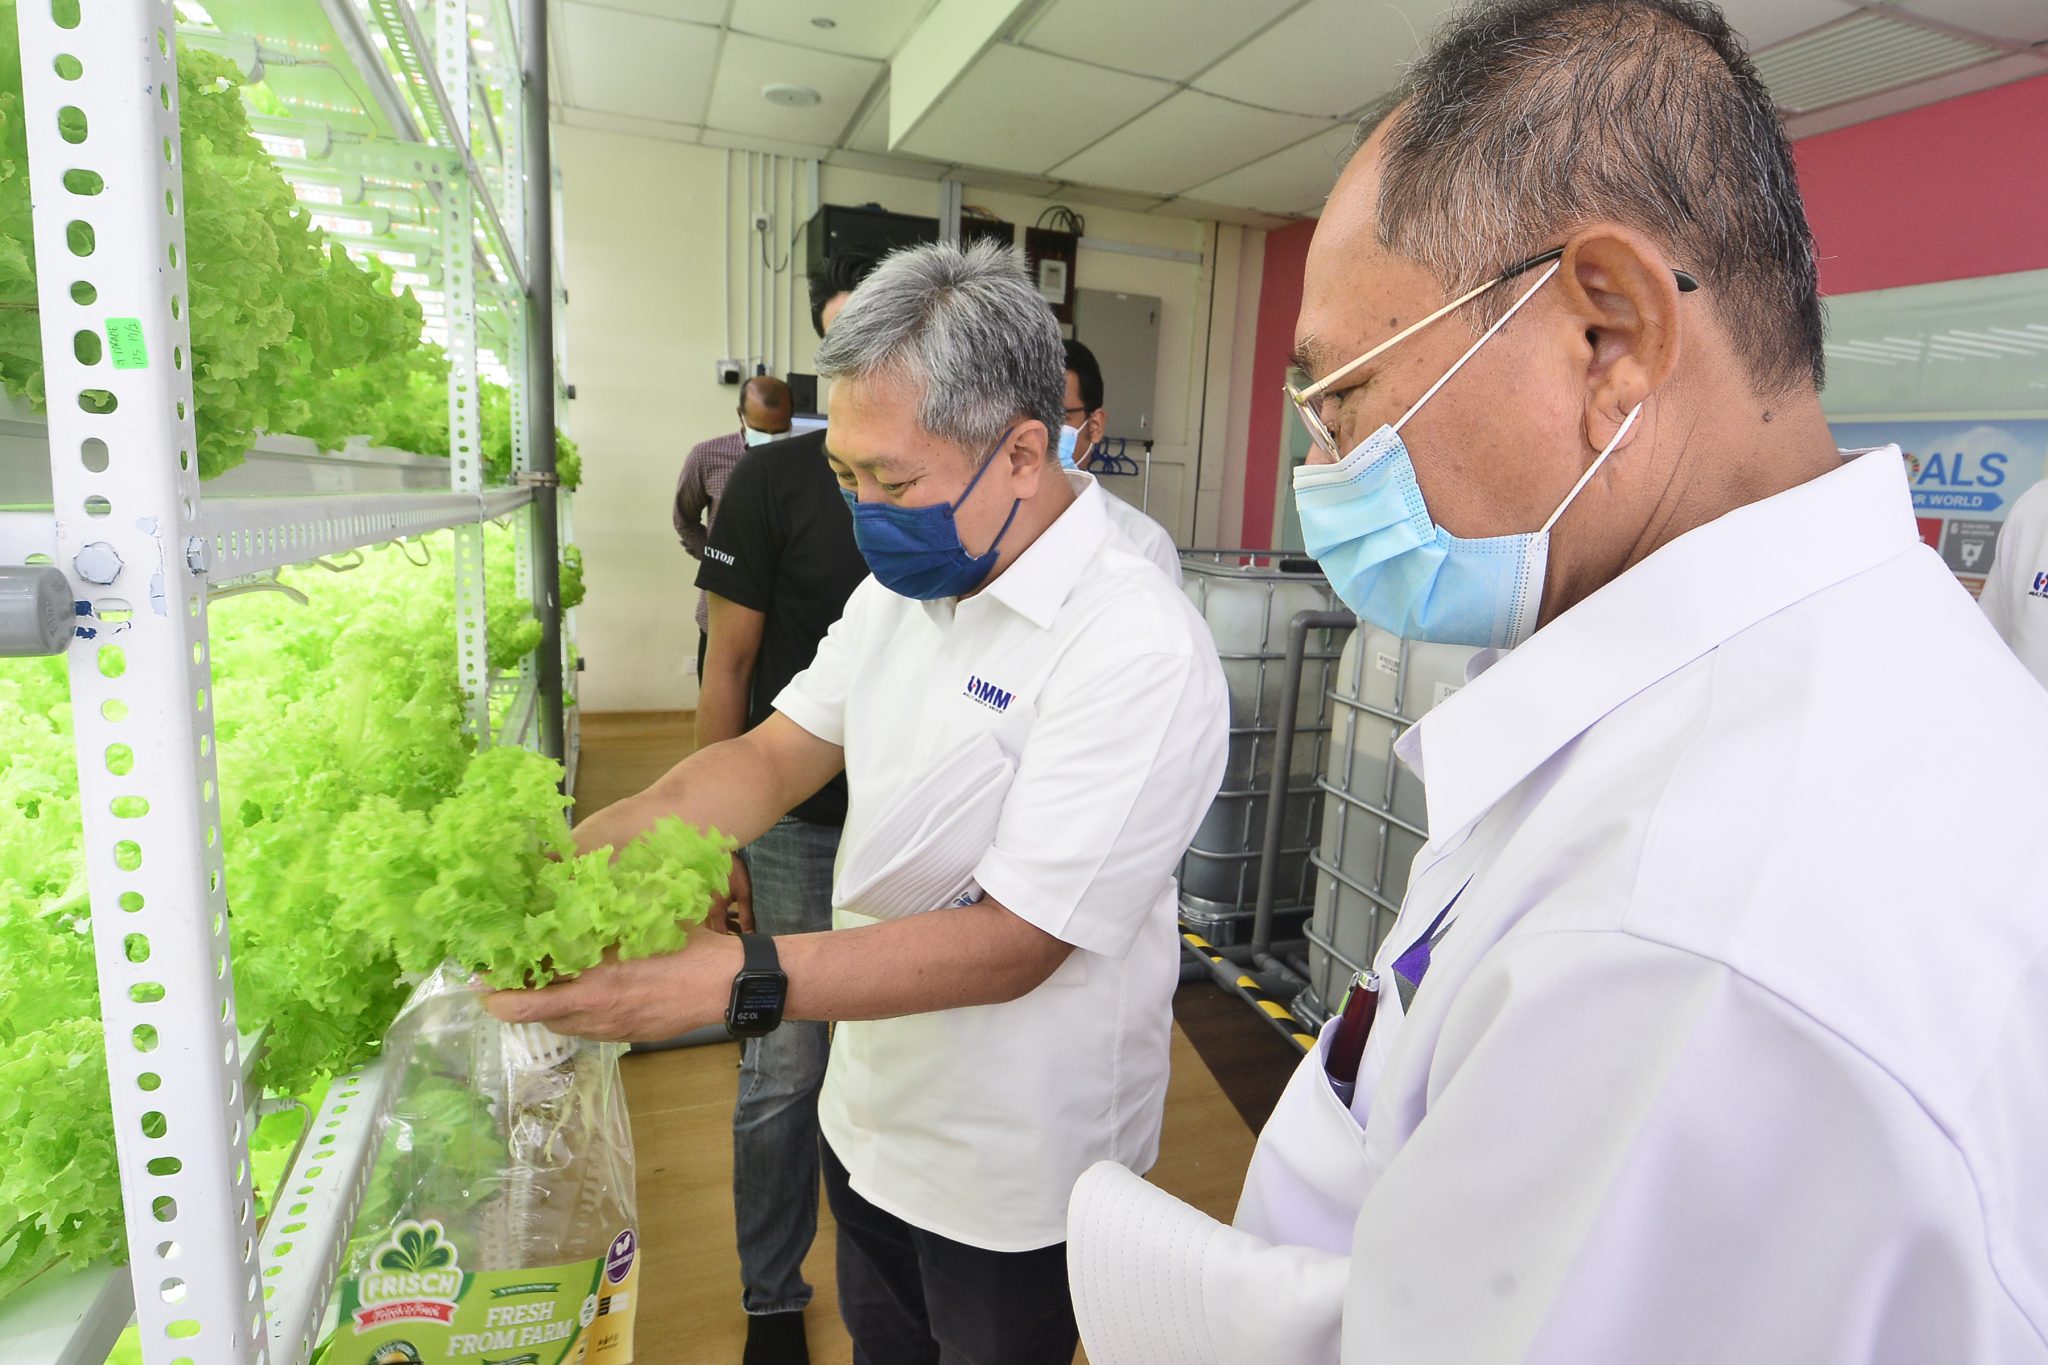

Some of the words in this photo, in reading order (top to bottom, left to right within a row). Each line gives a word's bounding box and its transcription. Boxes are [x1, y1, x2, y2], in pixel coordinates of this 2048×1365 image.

[1930, 494, 1983, 507] WORLD
[1950, 522, 1959, 534] 6
[737, 1012, 759, 1020] 10:29
[367, 1273, 456, 1299] FRISCH
[485, 1300, 556, 1328] FRESH
[446, 1328, 517, 1357] FROM
[517, 1318, 574, 1347] FARM
